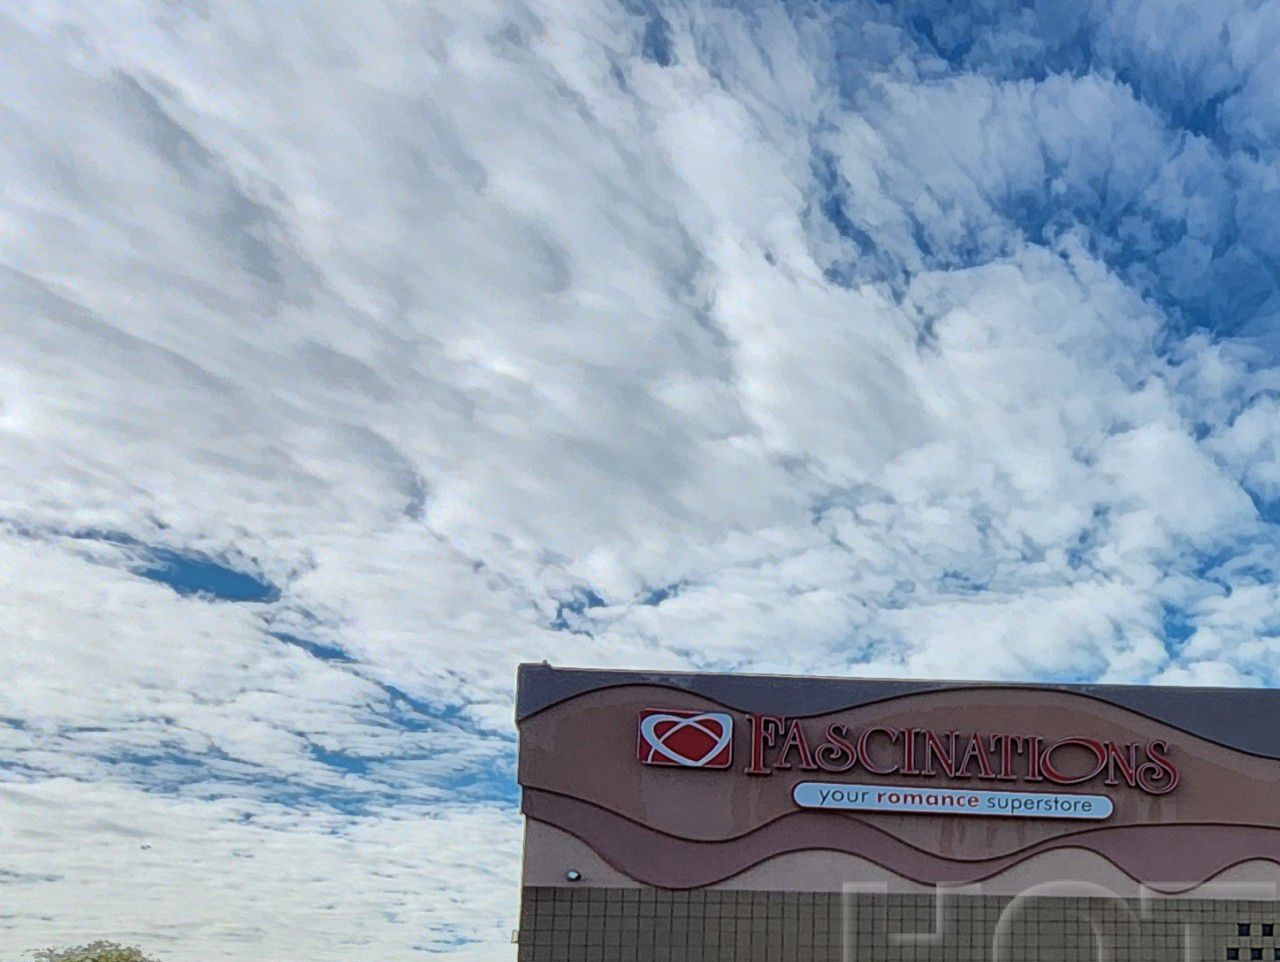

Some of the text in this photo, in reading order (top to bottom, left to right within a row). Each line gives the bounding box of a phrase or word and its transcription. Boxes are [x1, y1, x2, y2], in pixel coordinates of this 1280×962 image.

[744, 713, 1180, 795] FASCINATIONS
[818, 787, 1093, 813] your romance superstore
